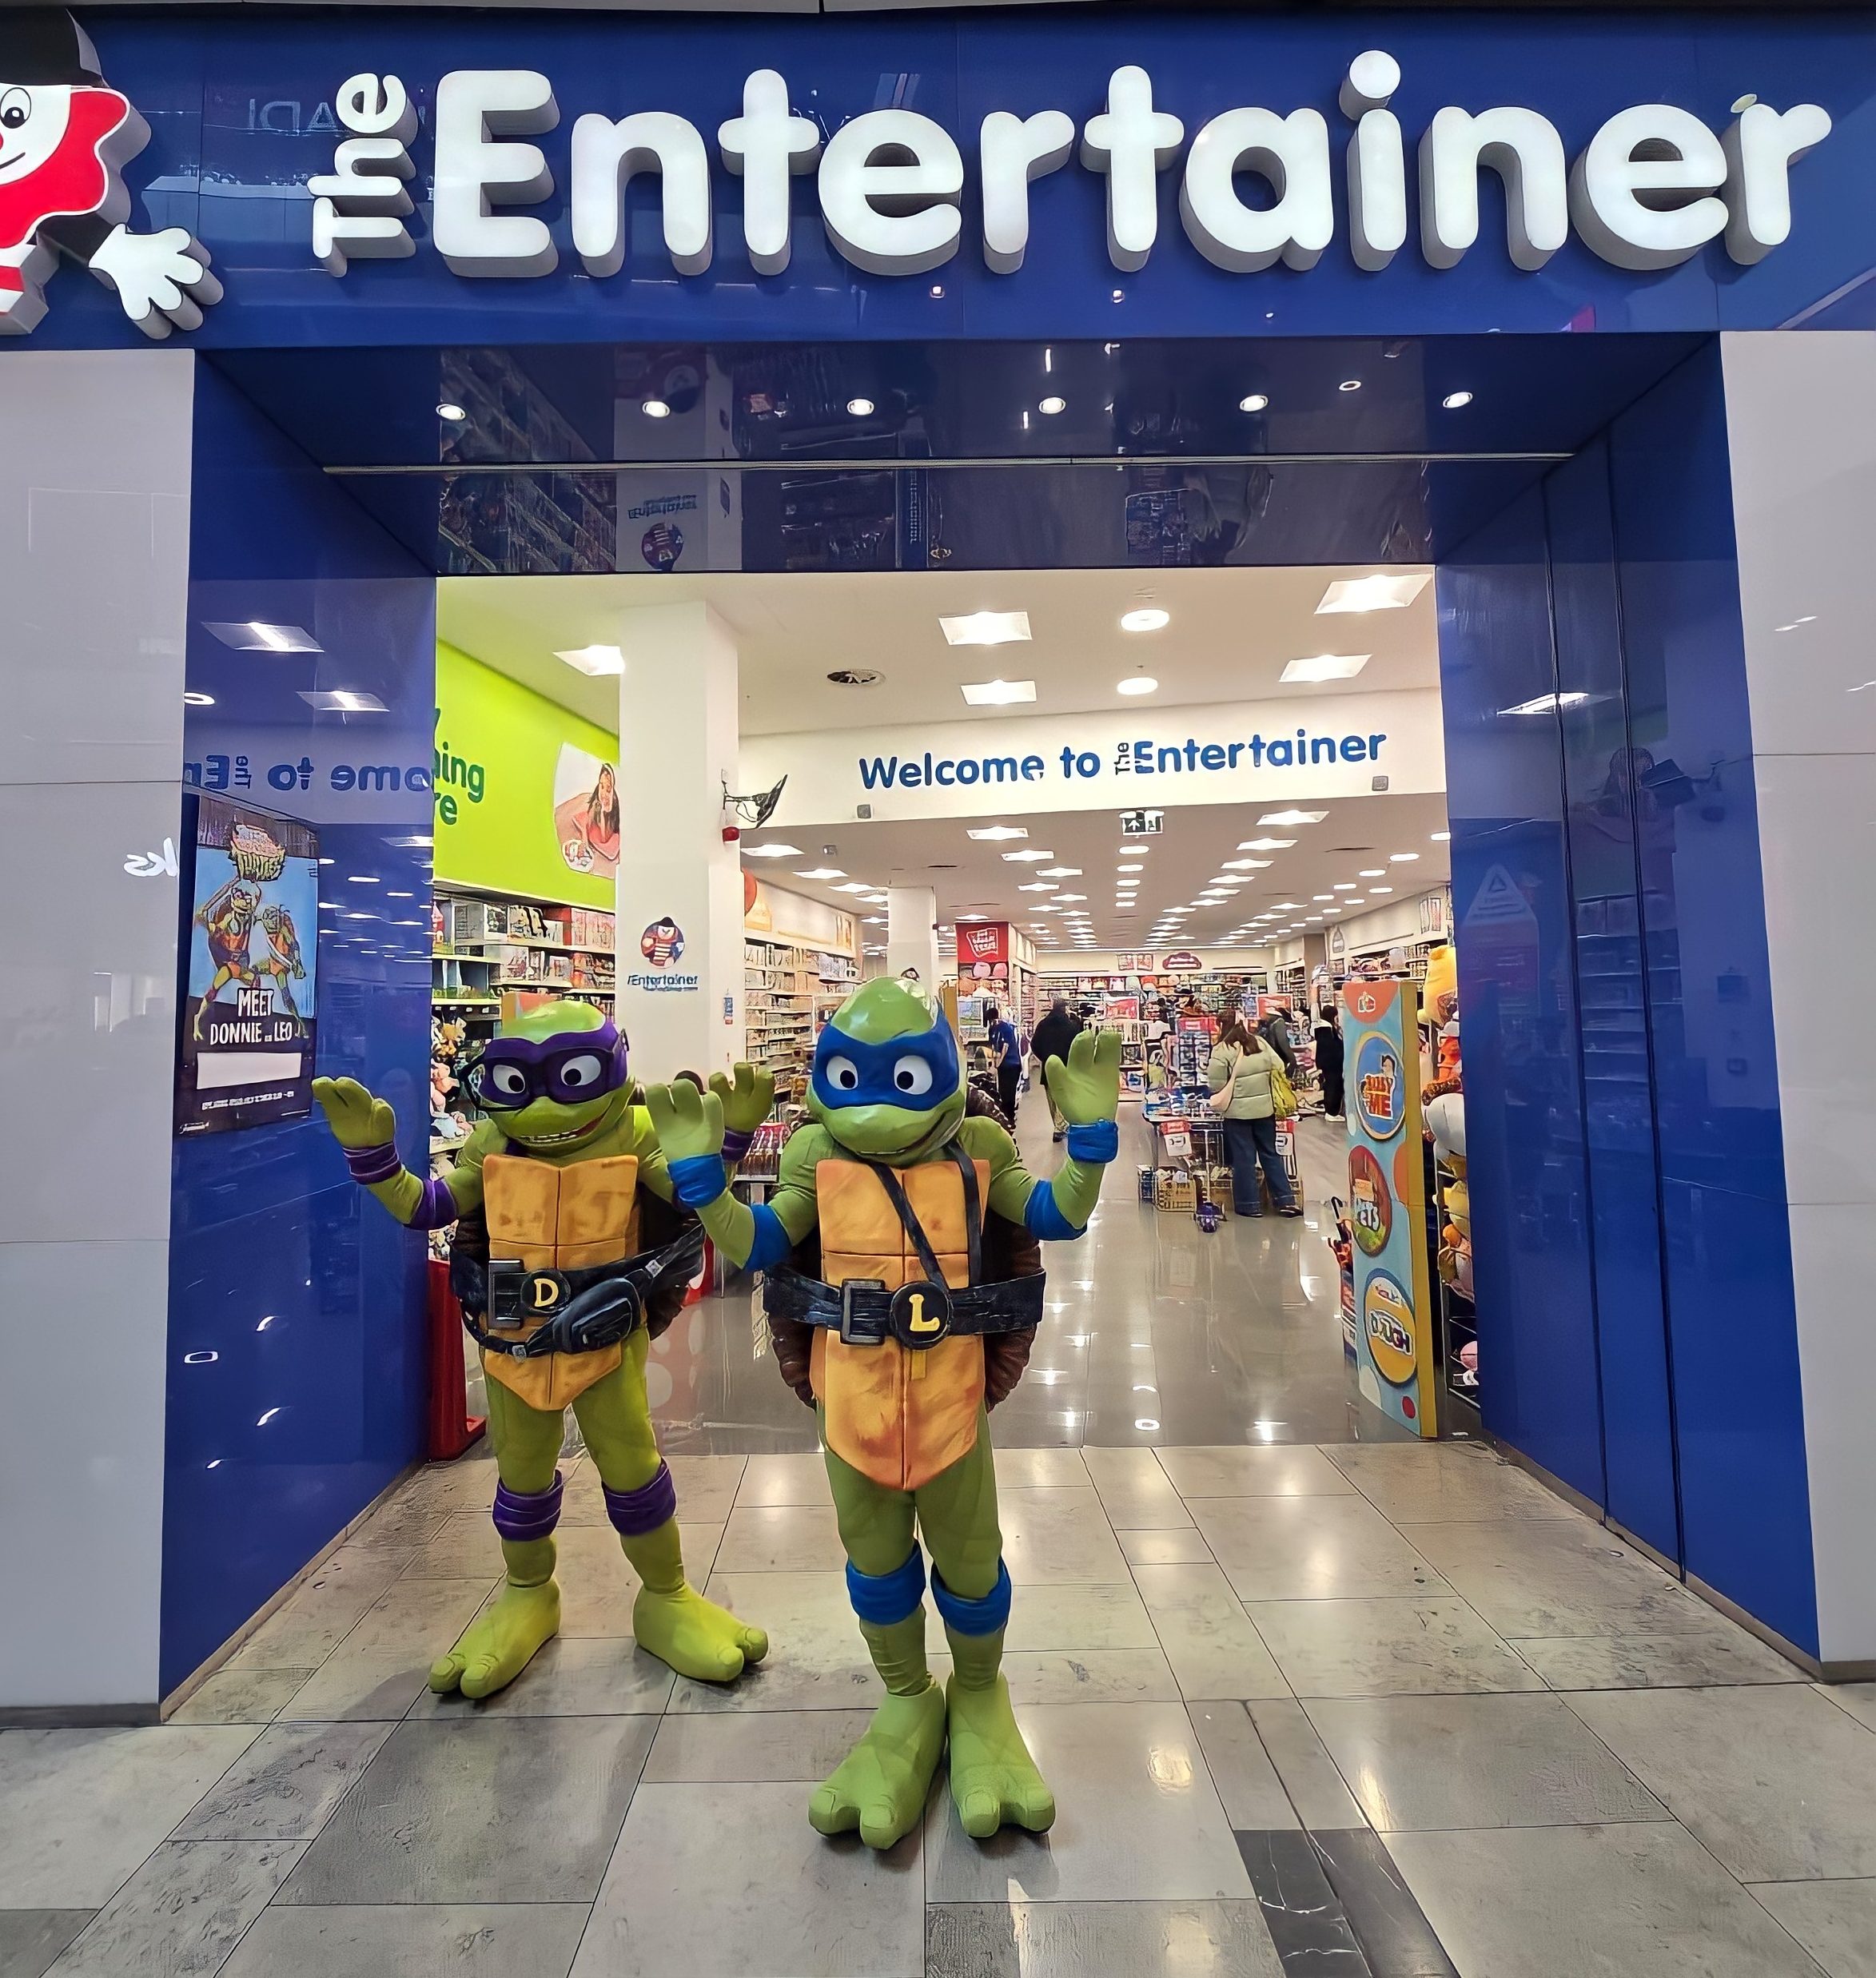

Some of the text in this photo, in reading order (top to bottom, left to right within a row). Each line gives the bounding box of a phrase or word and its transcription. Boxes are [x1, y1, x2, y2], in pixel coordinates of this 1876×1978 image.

[307, 50, 1832, 277] The Entertainer
[859, 729, 1387, 790] Welcome to The Entertainer
[238, 989, 274, 1017] MEET
[209, 1021, 293, 1045] DONNIE LEO
[533, 1278, 559, 1308] D
[908, 1293, 941, 1333] L
